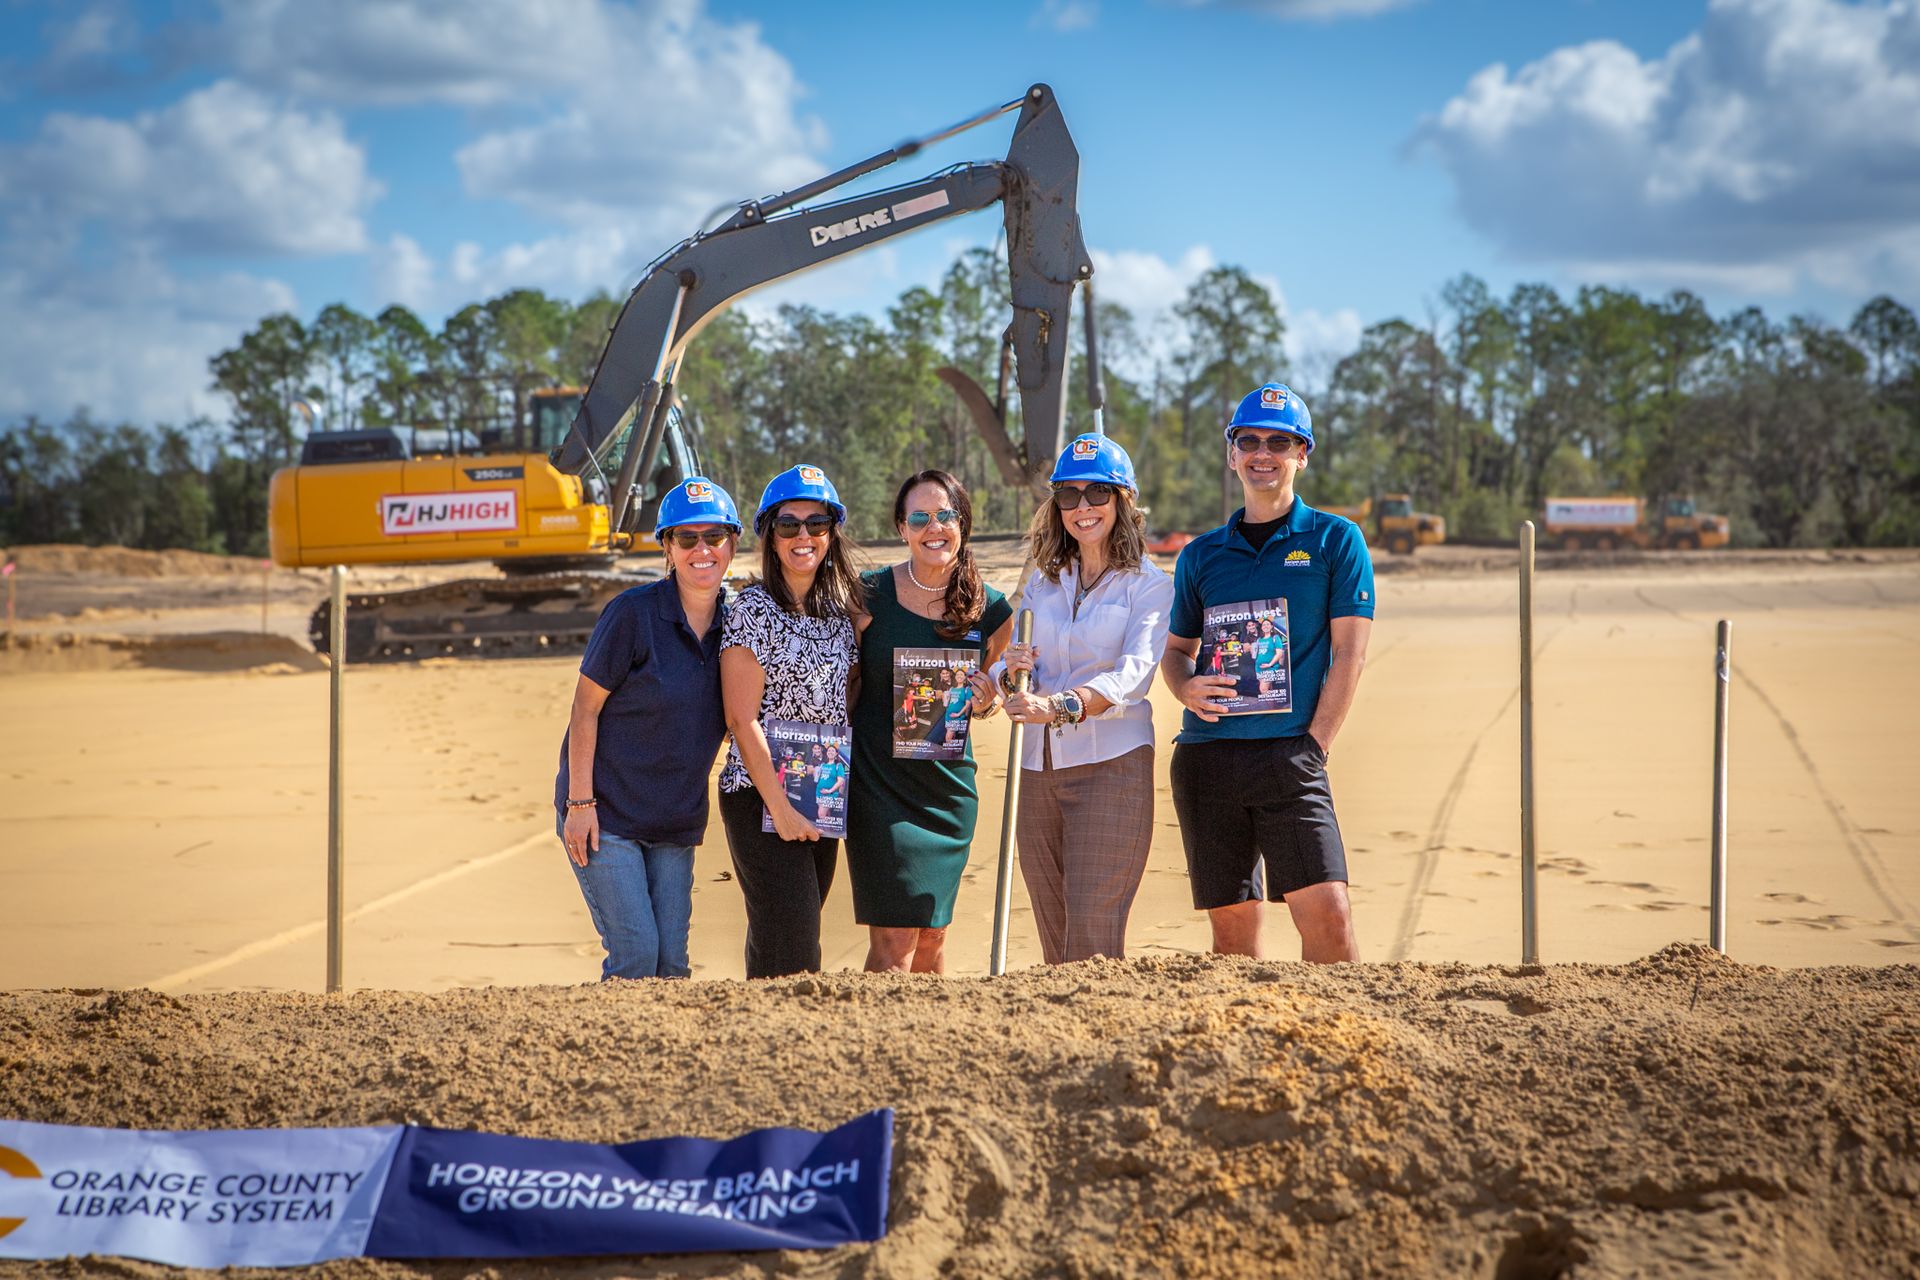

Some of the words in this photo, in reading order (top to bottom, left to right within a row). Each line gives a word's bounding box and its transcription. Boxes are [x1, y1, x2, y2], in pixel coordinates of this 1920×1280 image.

[418, 501, 510, 523] HJHIGH
[1208, 611, 1251, 625] horizon
[1253, 607, 1282, 619] west
[901, 654, 946, 668] horizon
[948, 658, 976, 669] west
[774, 726, 818, 742] horizon
[820, 735, 848, 745] west
[51, 1170, 207, 1195] ORANGE
[215, 1171, 364, 1198] COUNTY
[427, 1162, 602, 1190] HORIZON
[611, 1176, 707, 1201] WEST
[713, 1159, 860, 1201] BRANCH
[56, 1194, 200, 1222] LIBRARY
[206, 1199, 334, 1224] SYSTEM
[458, 1186, 625, 1214] GROUND
[633, 1190, 818, 1221] BREAKING
